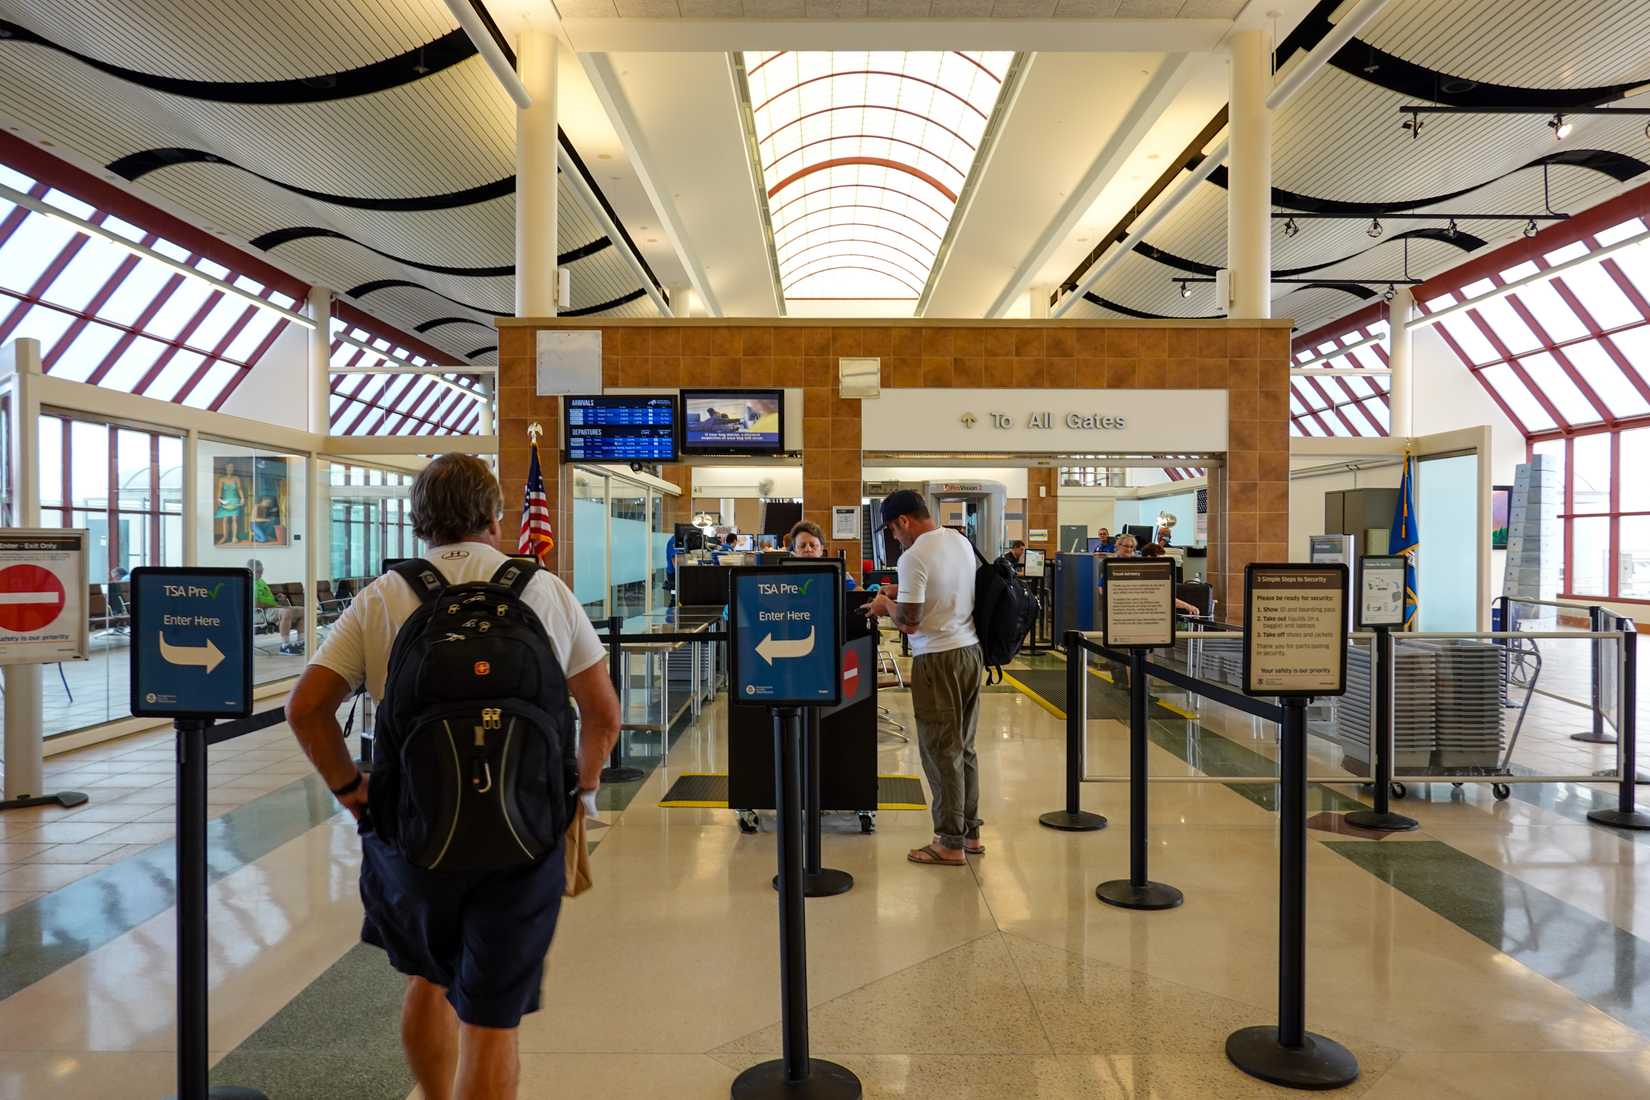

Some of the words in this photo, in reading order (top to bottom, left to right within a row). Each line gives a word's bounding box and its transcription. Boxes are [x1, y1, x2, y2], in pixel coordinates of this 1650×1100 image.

[989, 412, 1012, 429] To
[1028, 412, 1052, 429] All
[1066, 412, 1127, 429] Gates
[163, 586, 186, 597] TSA
[758, 584, 778, 594] TSA
[164, 614, 192, 625] Enter
[194, 616, 220, 626] Here
[760, 611, 785, 621] Enter
[787, 611, 810, 620] Here
